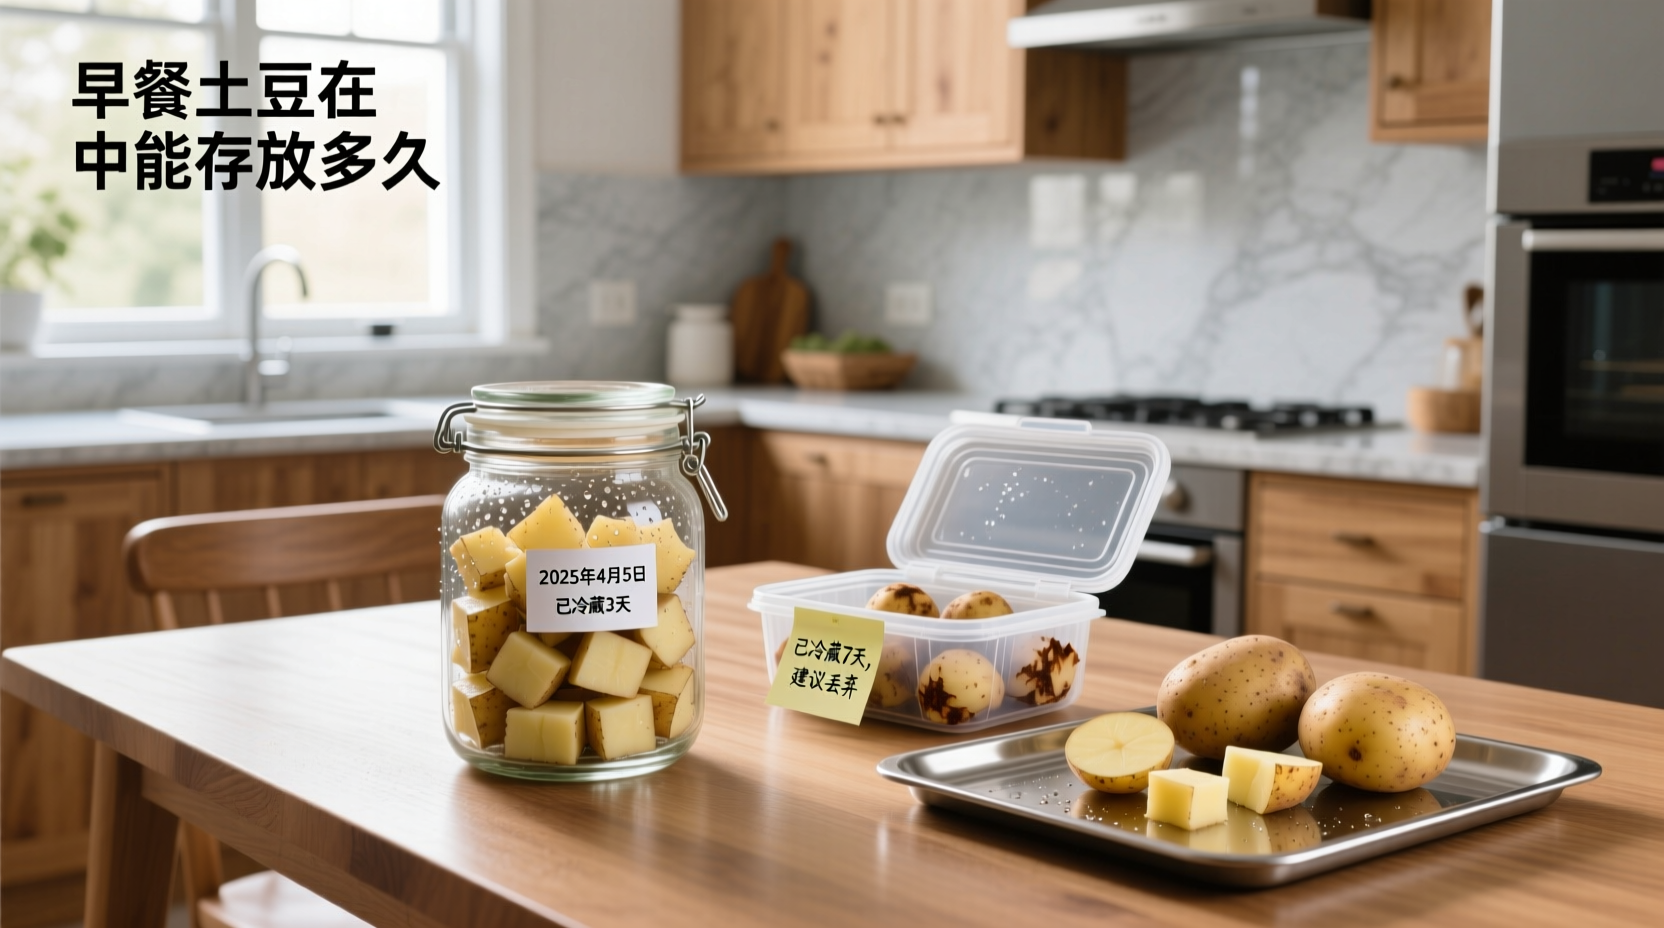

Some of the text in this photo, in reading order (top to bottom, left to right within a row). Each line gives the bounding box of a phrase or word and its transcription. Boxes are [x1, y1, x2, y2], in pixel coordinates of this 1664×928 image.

[539, 565, 646, 586] 2025年4月5日
[789, 667, 858, 700] 建议丢弃
